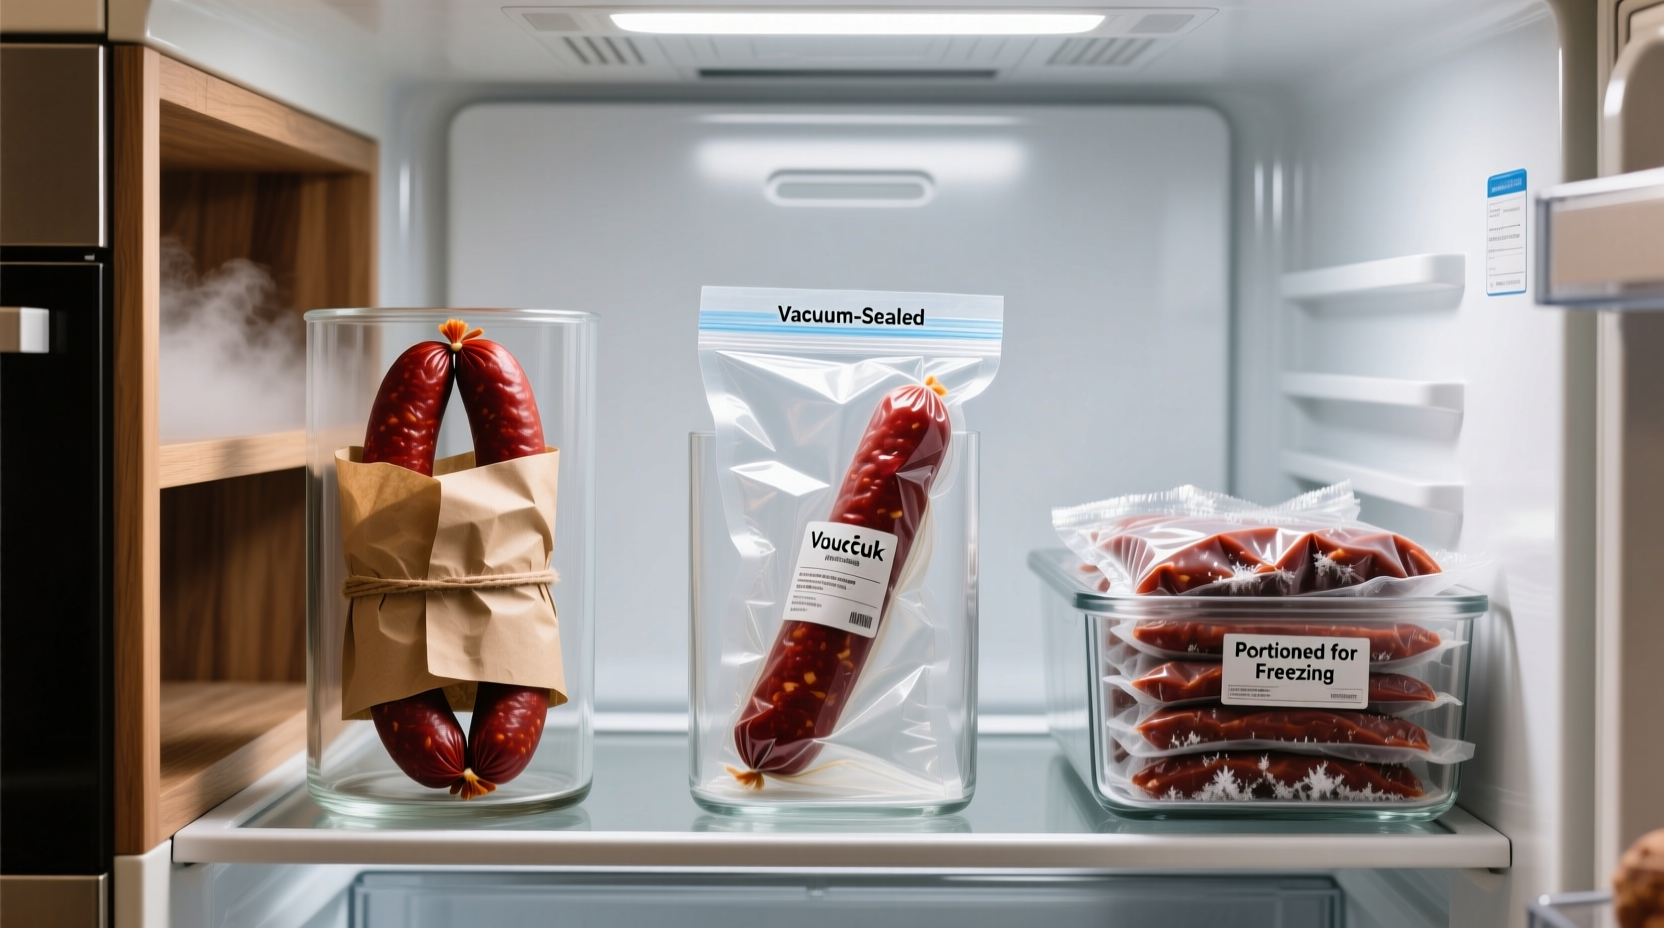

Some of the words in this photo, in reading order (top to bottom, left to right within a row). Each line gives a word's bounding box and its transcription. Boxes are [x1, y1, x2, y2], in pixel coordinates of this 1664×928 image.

[778, 305, 925, 326] Vacuum-Sealed
[1235, 641, 1325, 660] Portioned
[1331, 643, 1358, 661] for
[1256, 663, 1334, 685] Freezing
